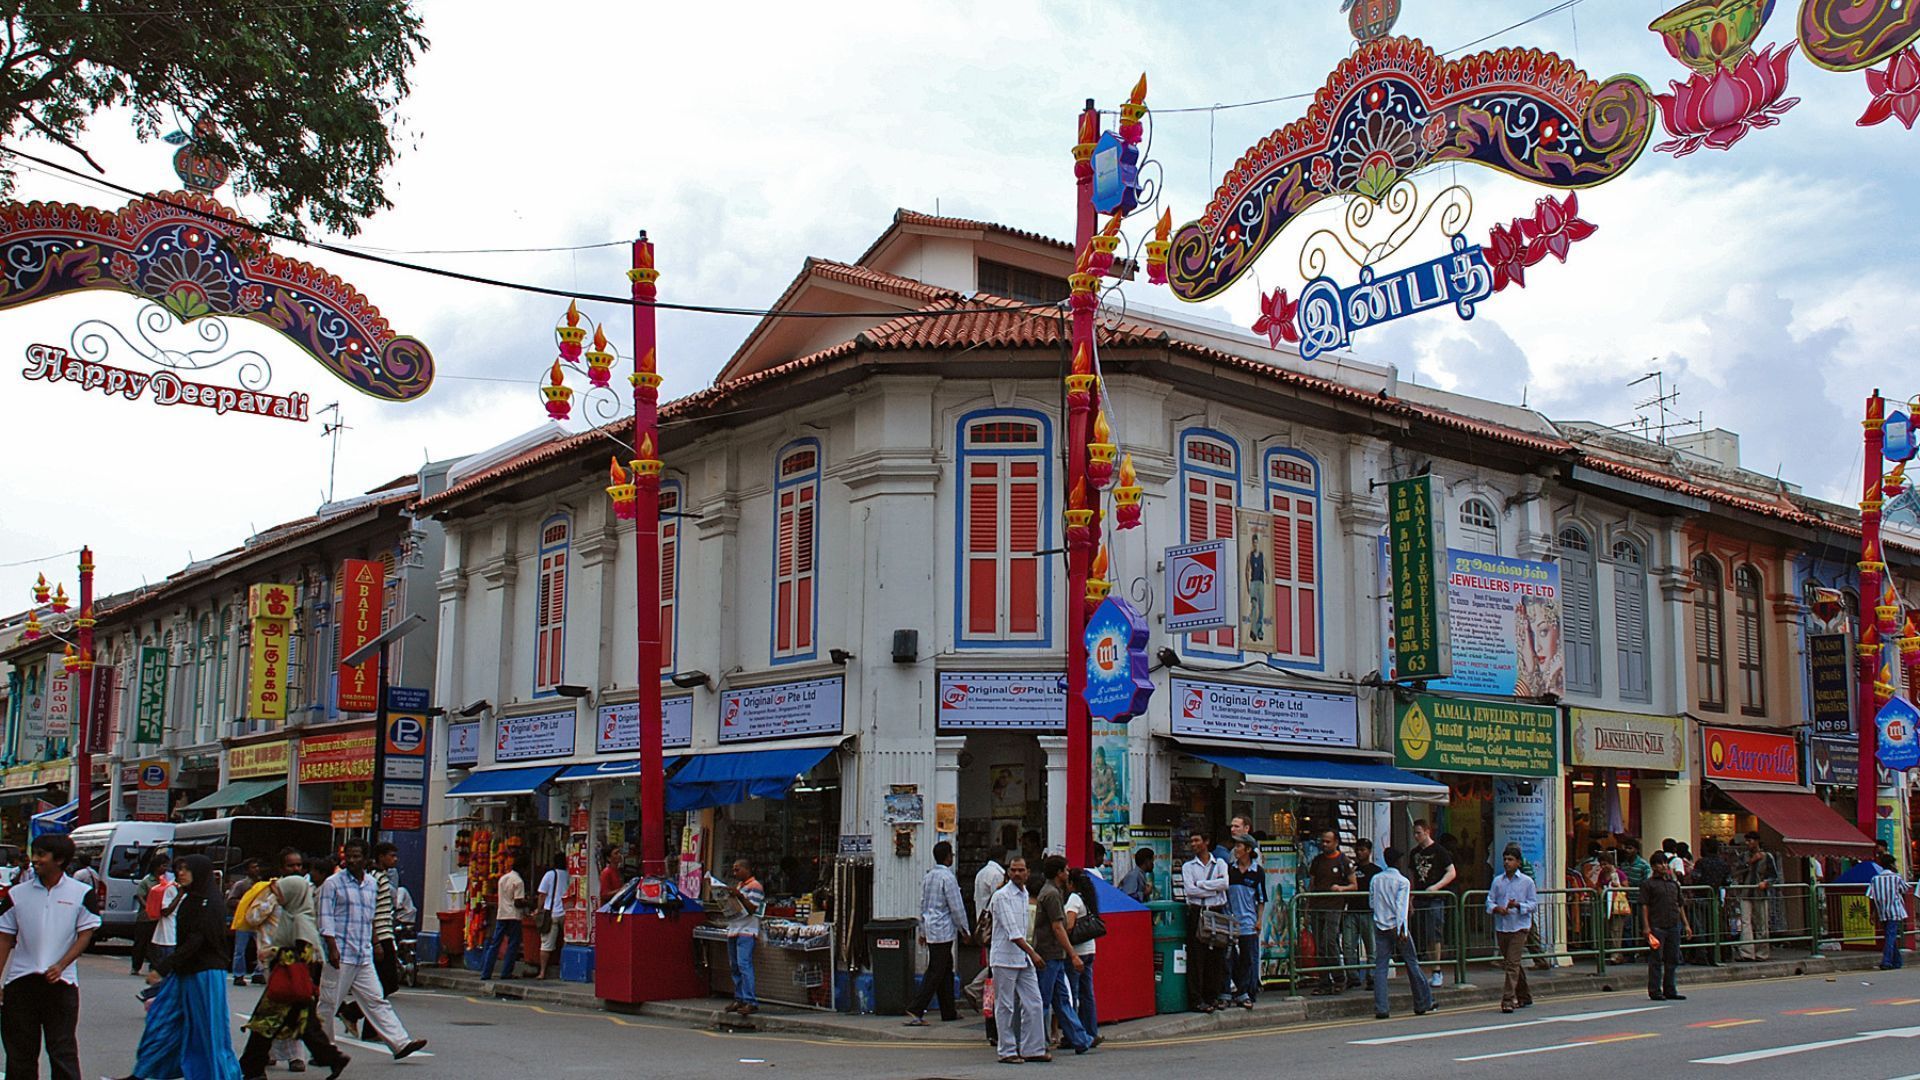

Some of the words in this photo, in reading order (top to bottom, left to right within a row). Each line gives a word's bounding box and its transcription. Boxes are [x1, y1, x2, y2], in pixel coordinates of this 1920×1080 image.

[1300, 235, 1491, 358] இன்பத்
[23, 343, 150, 400] Happy
[151, 370, 309, 421] Deepavali
[1414, 483, 1426, 548] KAMALA
[1449, 573, 1510, 592] JEWELLERS
[1513, 582, 1533, 595] PTE
[1536, 585, 1554, 598] LTD
[356, 585, 369, 632] BATU
[1417, 552, 1430, 650] JEWELLERS
[354, 635, 367, 693] PHAT
[1408, 655, 1426, 671] 63
[140, 655, 155, 734] JEWEL
[151, 651, 167, 739] PALACE
[743, 695, 773, 709] Original
[787, 692, 801, 702] Pte
[803, 689, 816, 701] Ltd
[967, 686, 1007, 695] Original
[1027, 686, 1044, 694] Pte
[1210, 692, 1250, 709] Original
[1269, 698, 1285, 709] Pte
[1287, 700, 1303, 711] Ltd
[1433, 703, 1471, 720] KAMALA
[1473, 707, 1519, 724] JEWELLERS
[1520, 711, 1536, 727] PTE
[1537, 713, 1552, 728] LTD
[1833, 720, 1848, 730] 69
[1450, 754, 1481, 767] Serangoon
[1501, 758, 1528, 769] Singapore
[1488, 744, 1502, 755] Gold
[1727, 744, 1794, 775] Auroville
